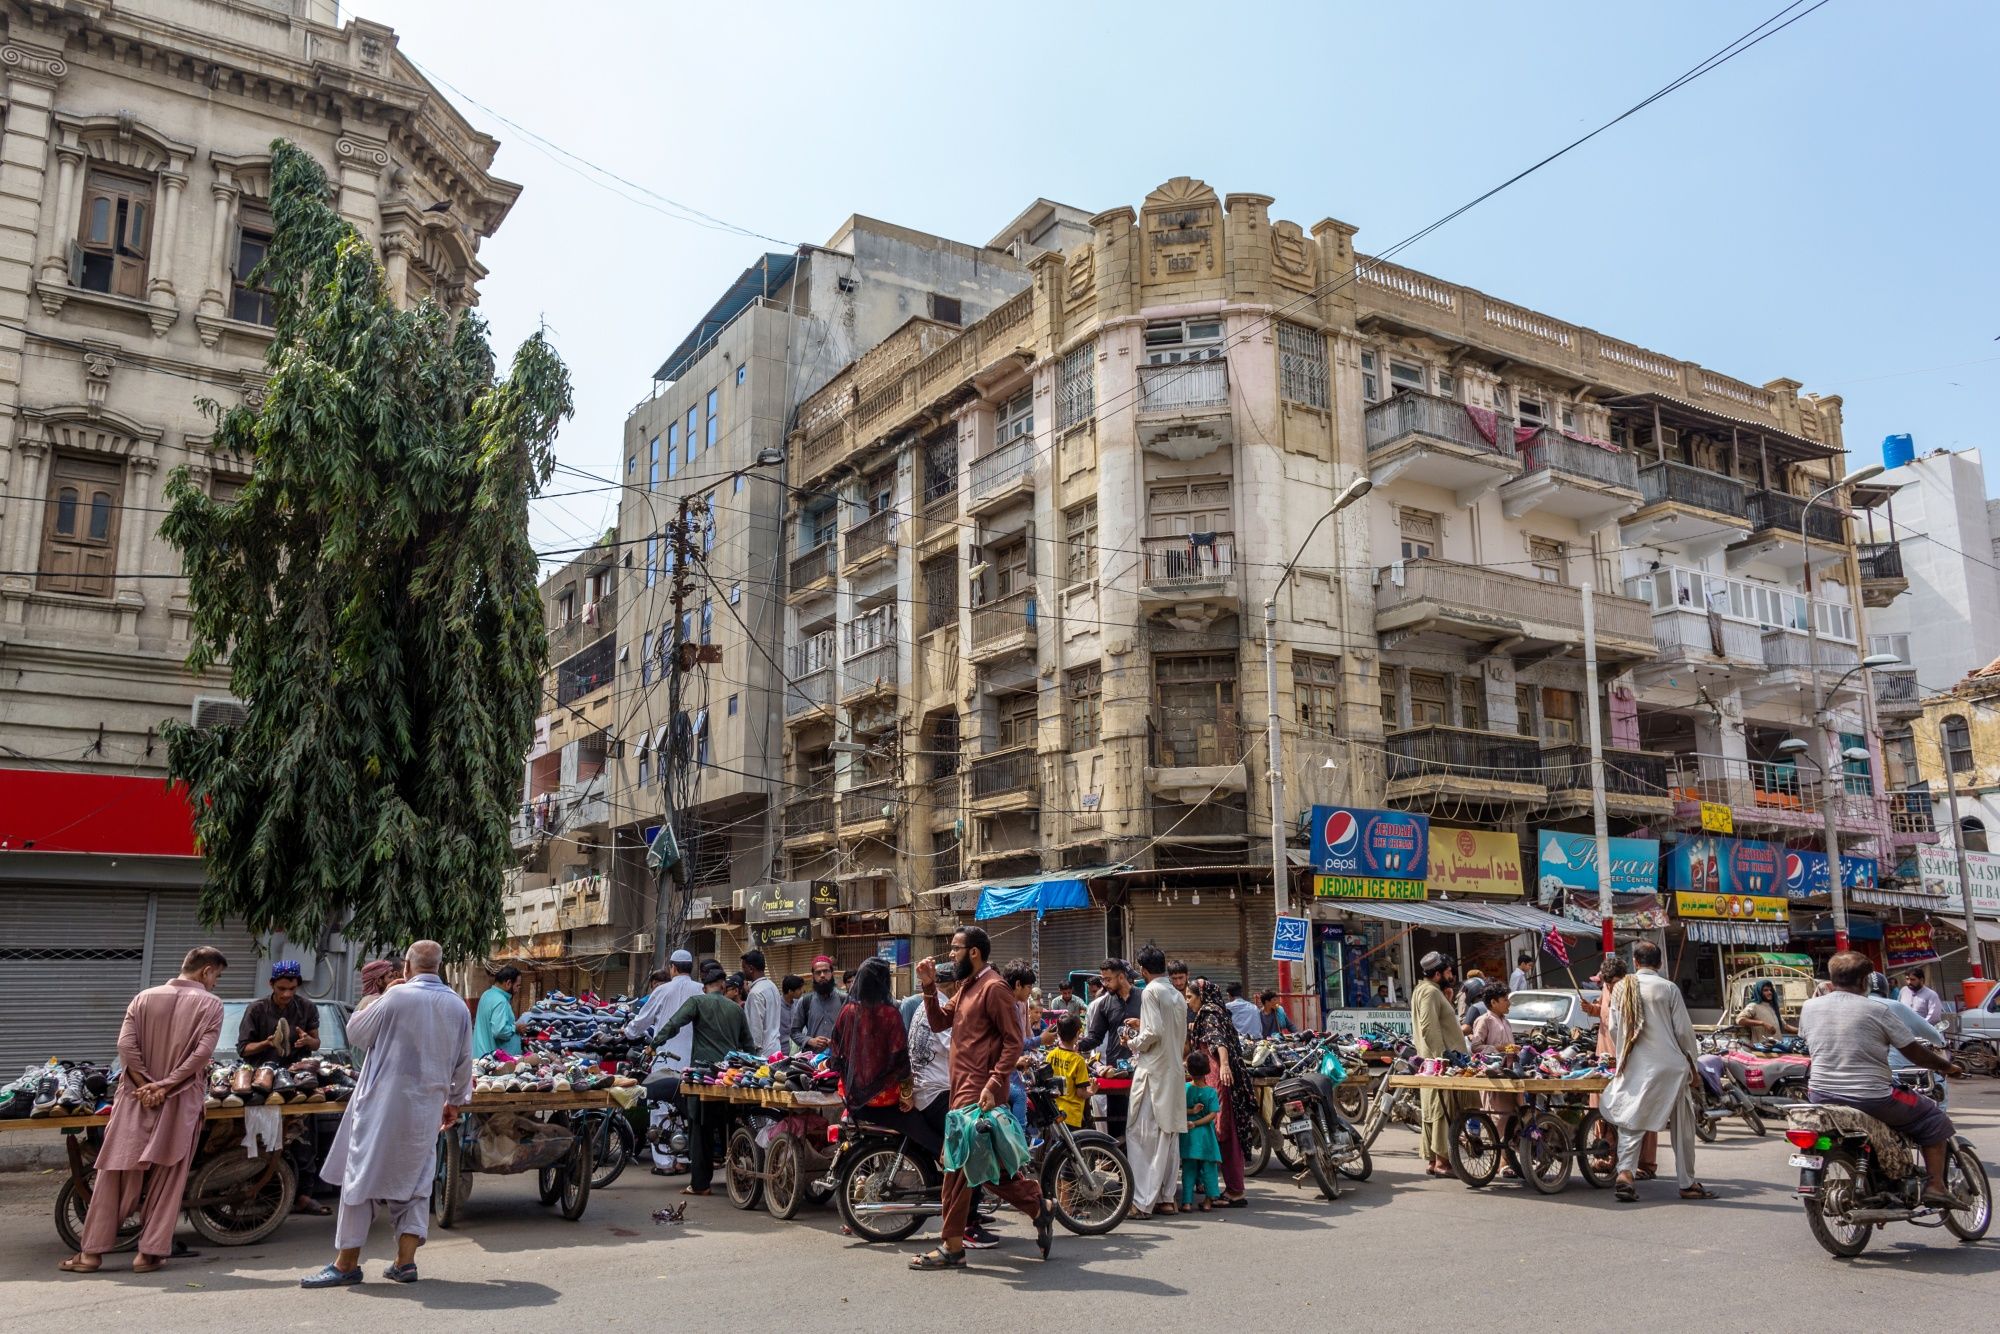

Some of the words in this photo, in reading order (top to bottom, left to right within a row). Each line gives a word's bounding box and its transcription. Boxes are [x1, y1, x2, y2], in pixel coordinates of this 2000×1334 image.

[1375, 822, 1413, 837] JEDDAH
[1373, 837, 1386, 848] ICE
[1388, 838, 1413, 849] CREAM
[1325, 857, 1356, 871] pepsi
[1626, 875, 1653, 884] CENTRE
[1320, 877, 1363, 896] JEDDAH
[1367, 879, 1385, 897] ICE
[1388, 880, 1424, 899] CREAM
[1788, 889, 1804, 898] epsi
[1947, 881, 1954, 895] &
[1956, 882, 1982, 897] DHI
[762, 900, 778, 911] Crystal
